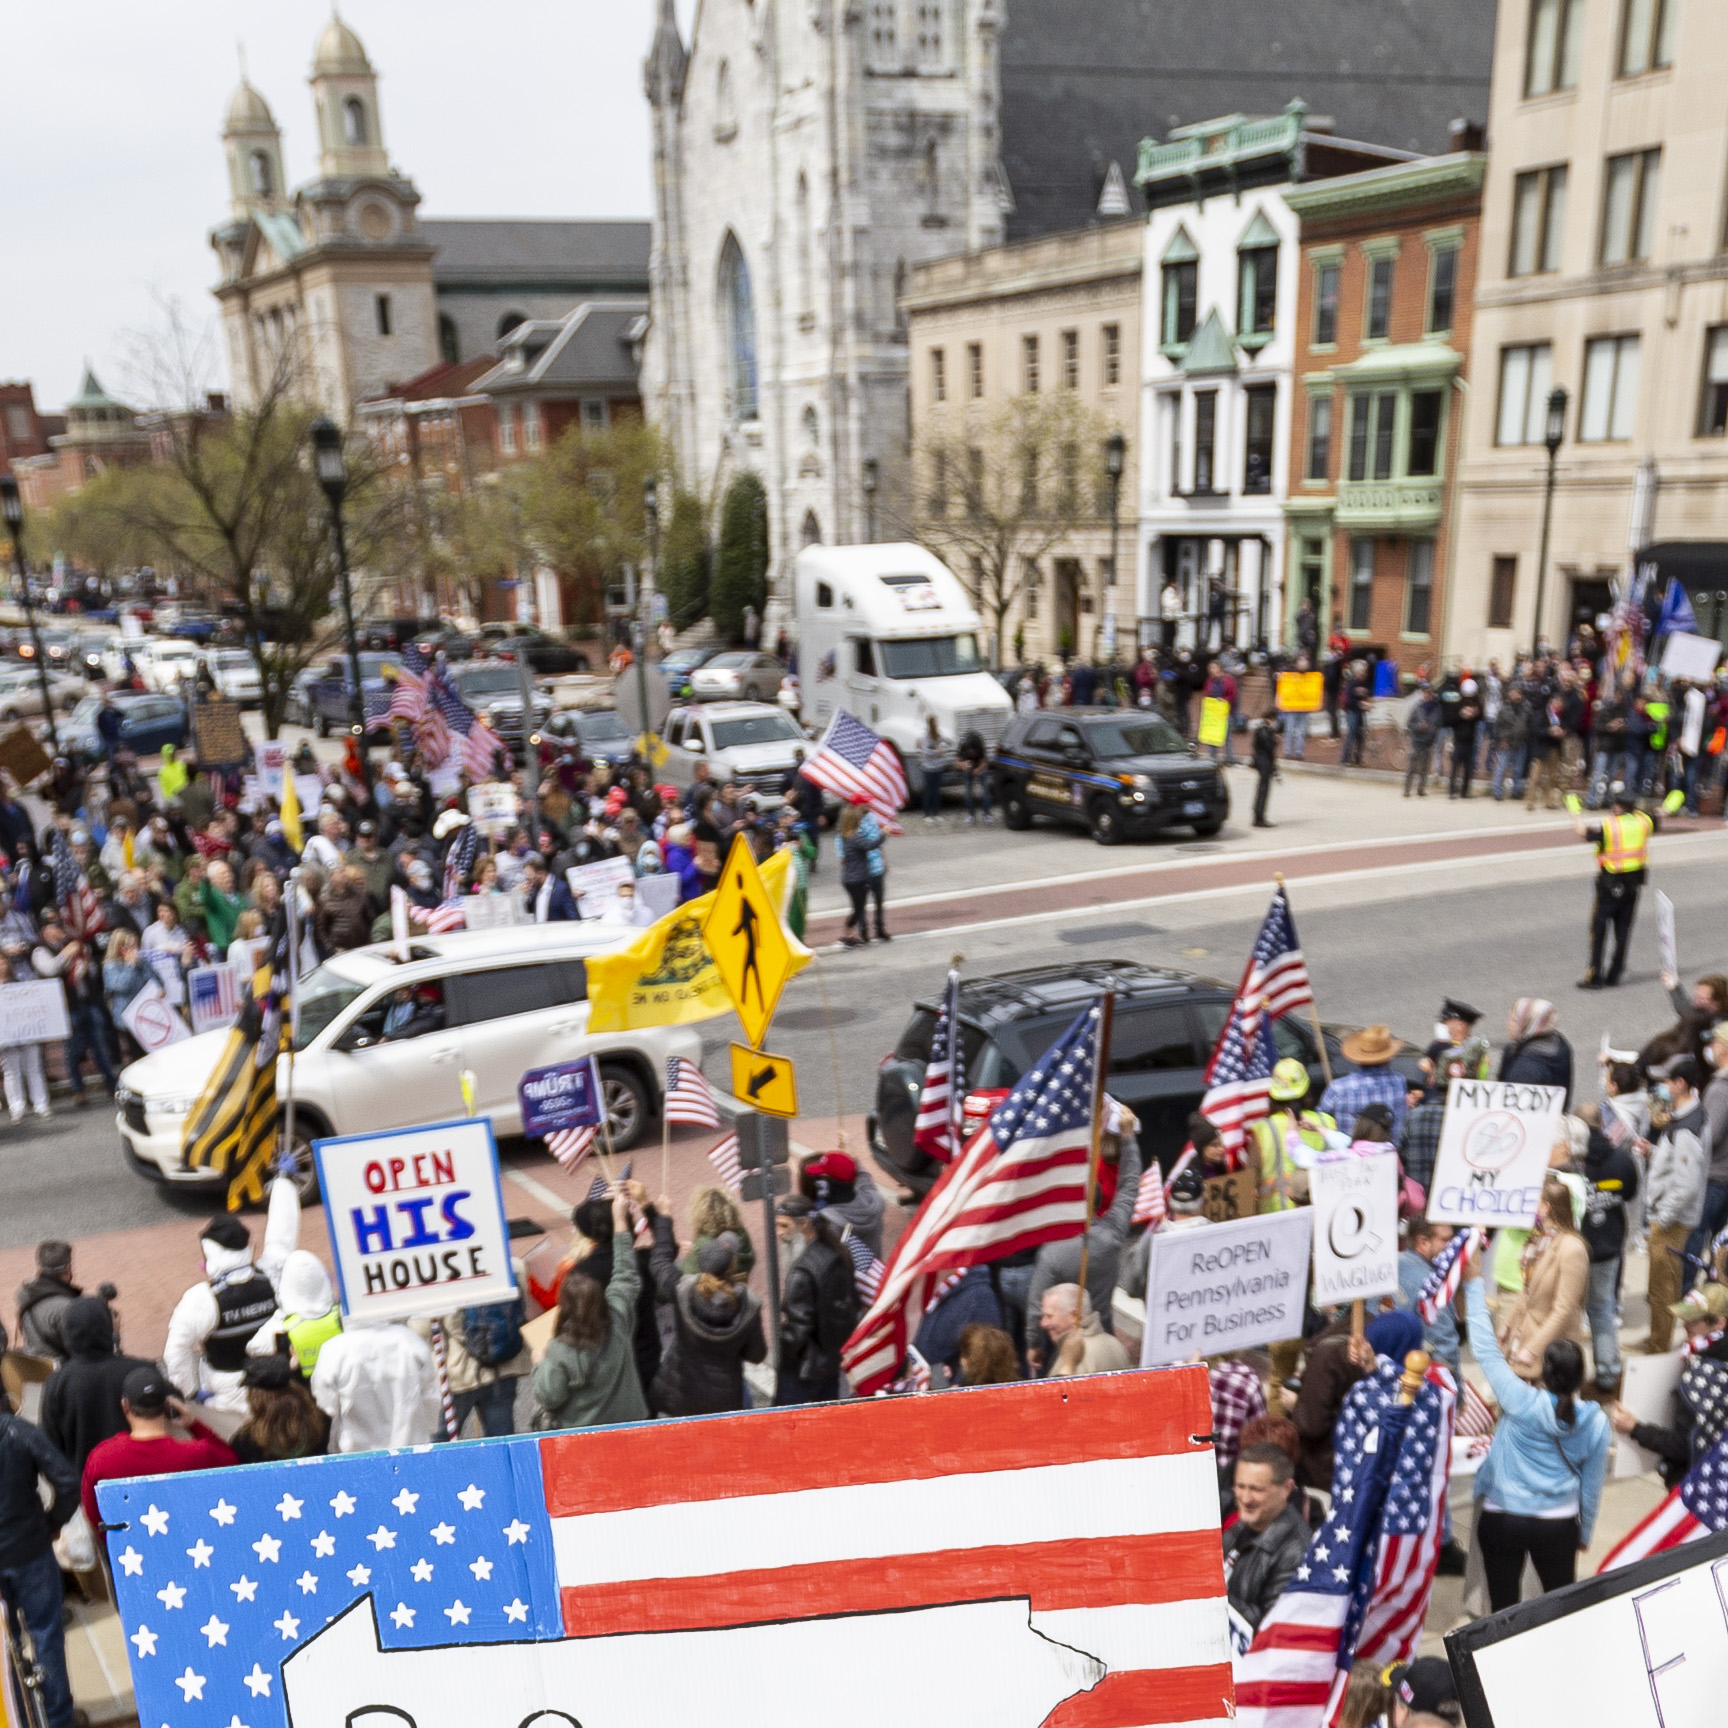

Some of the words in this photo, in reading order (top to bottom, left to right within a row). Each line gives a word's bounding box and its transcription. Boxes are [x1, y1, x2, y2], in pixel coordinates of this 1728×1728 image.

[1456, 1084, 1497, 1110] MY
[1503, 1084, 1558, 1113] BODY
[363, 1149, 456, 1194] OPEN
[1468, 1169, 1500, 1188] MY
[1439, 1186, 1542, 1215] CHOICE
[350, 1190, 476, 1255] HIS
[1328, 1193, 1383, 1260] Q
[363, 1245, 487, 1295] HOUSE
[1191, 1238, 1272, 1275] ReOPEN
[1165, 1268, 1291, 1312] Pennsylvania
[1165, 1321, 1194, 1345] For
[1202, 1302, 1286, 1335] Business
